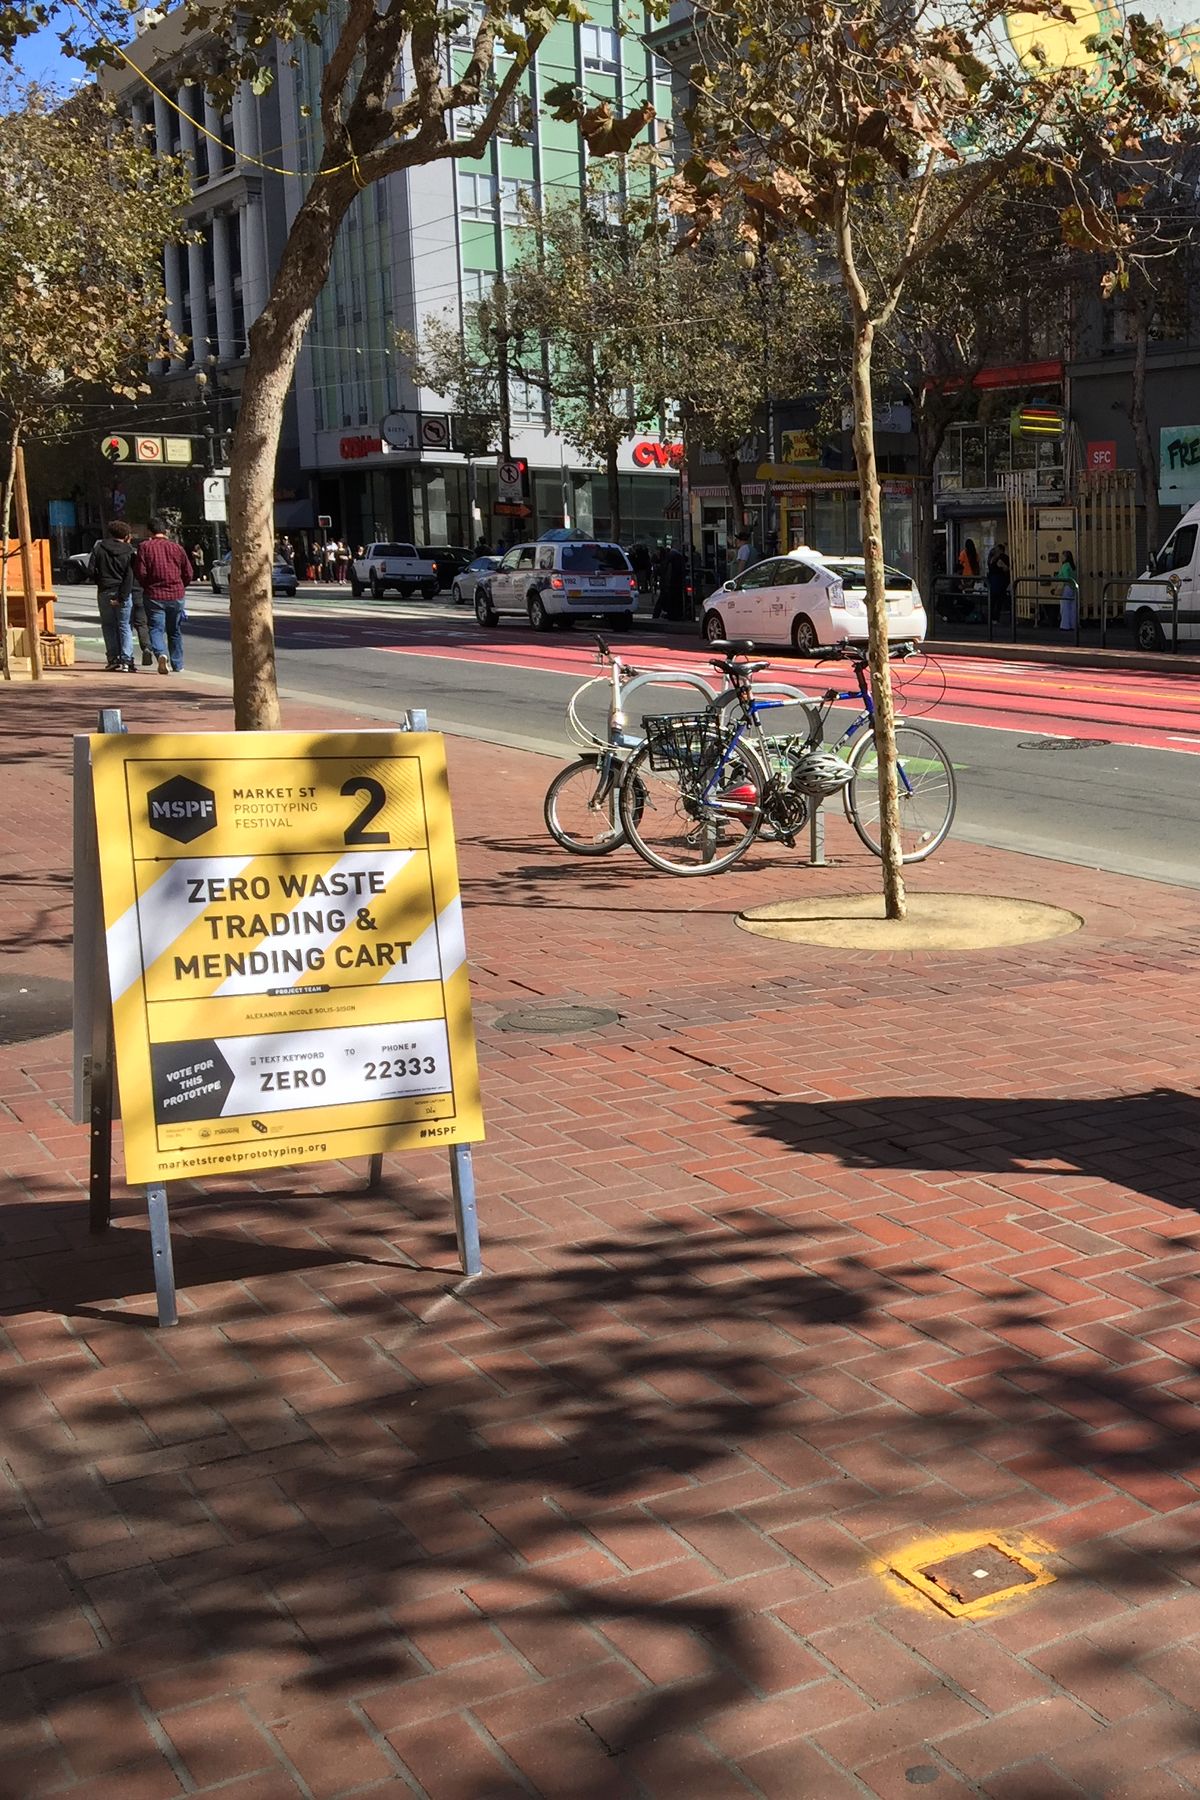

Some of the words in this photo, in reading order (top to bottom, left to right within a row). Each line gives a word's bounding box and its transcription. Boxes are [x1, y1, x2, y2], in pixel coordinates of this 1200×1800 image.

[1093, 450, 1111, 464] SFC
[233, 788, 293, 799] MARKET
[299, 787, 316, 798] ST
[152, 800, 214, 819] MSPF
[234, 802, 319, 814] PROTOTYPING
[340, 776, 391, 846] 2
[235, 817, 293, 829] FESTIVAL
[186, 876, 270, 904] ZERO
[277, 871, 387, 899] WASTE
[204, 908, 346, 940] TRADING
[355, 907, 378, 931] &
[174, 947, 325, 981] MENDING
[335, 941, 413, 969] CART
[275, 987, 302, 995] PROJECT
[246, 1011, 287, 1020] ALEXANDRA
[289, 1008, 313, 1016] NICOLE
[345, 1048, 356, 1056] TO
[381, 1043, 409, 1053] PHONE
[259, 1055, 281, 1064] TEXT
[282, 1052, 325, 1063] KEYWORD
[166, 1064, 193, 1082] VOTE
[194, 1059, 214, 1074] FOR
[364, 1056, 436, 1081] 22333
[179, 1074, 203, 1090] THIS
[260, 1067, 327, 1092] ZERO
[163, 1080, 222, 1109] PROTOTYPE
[420, 1126, 457, 1138] #MSPF
[158, 1142, 327, 1171] marketstreetprototyping.org
